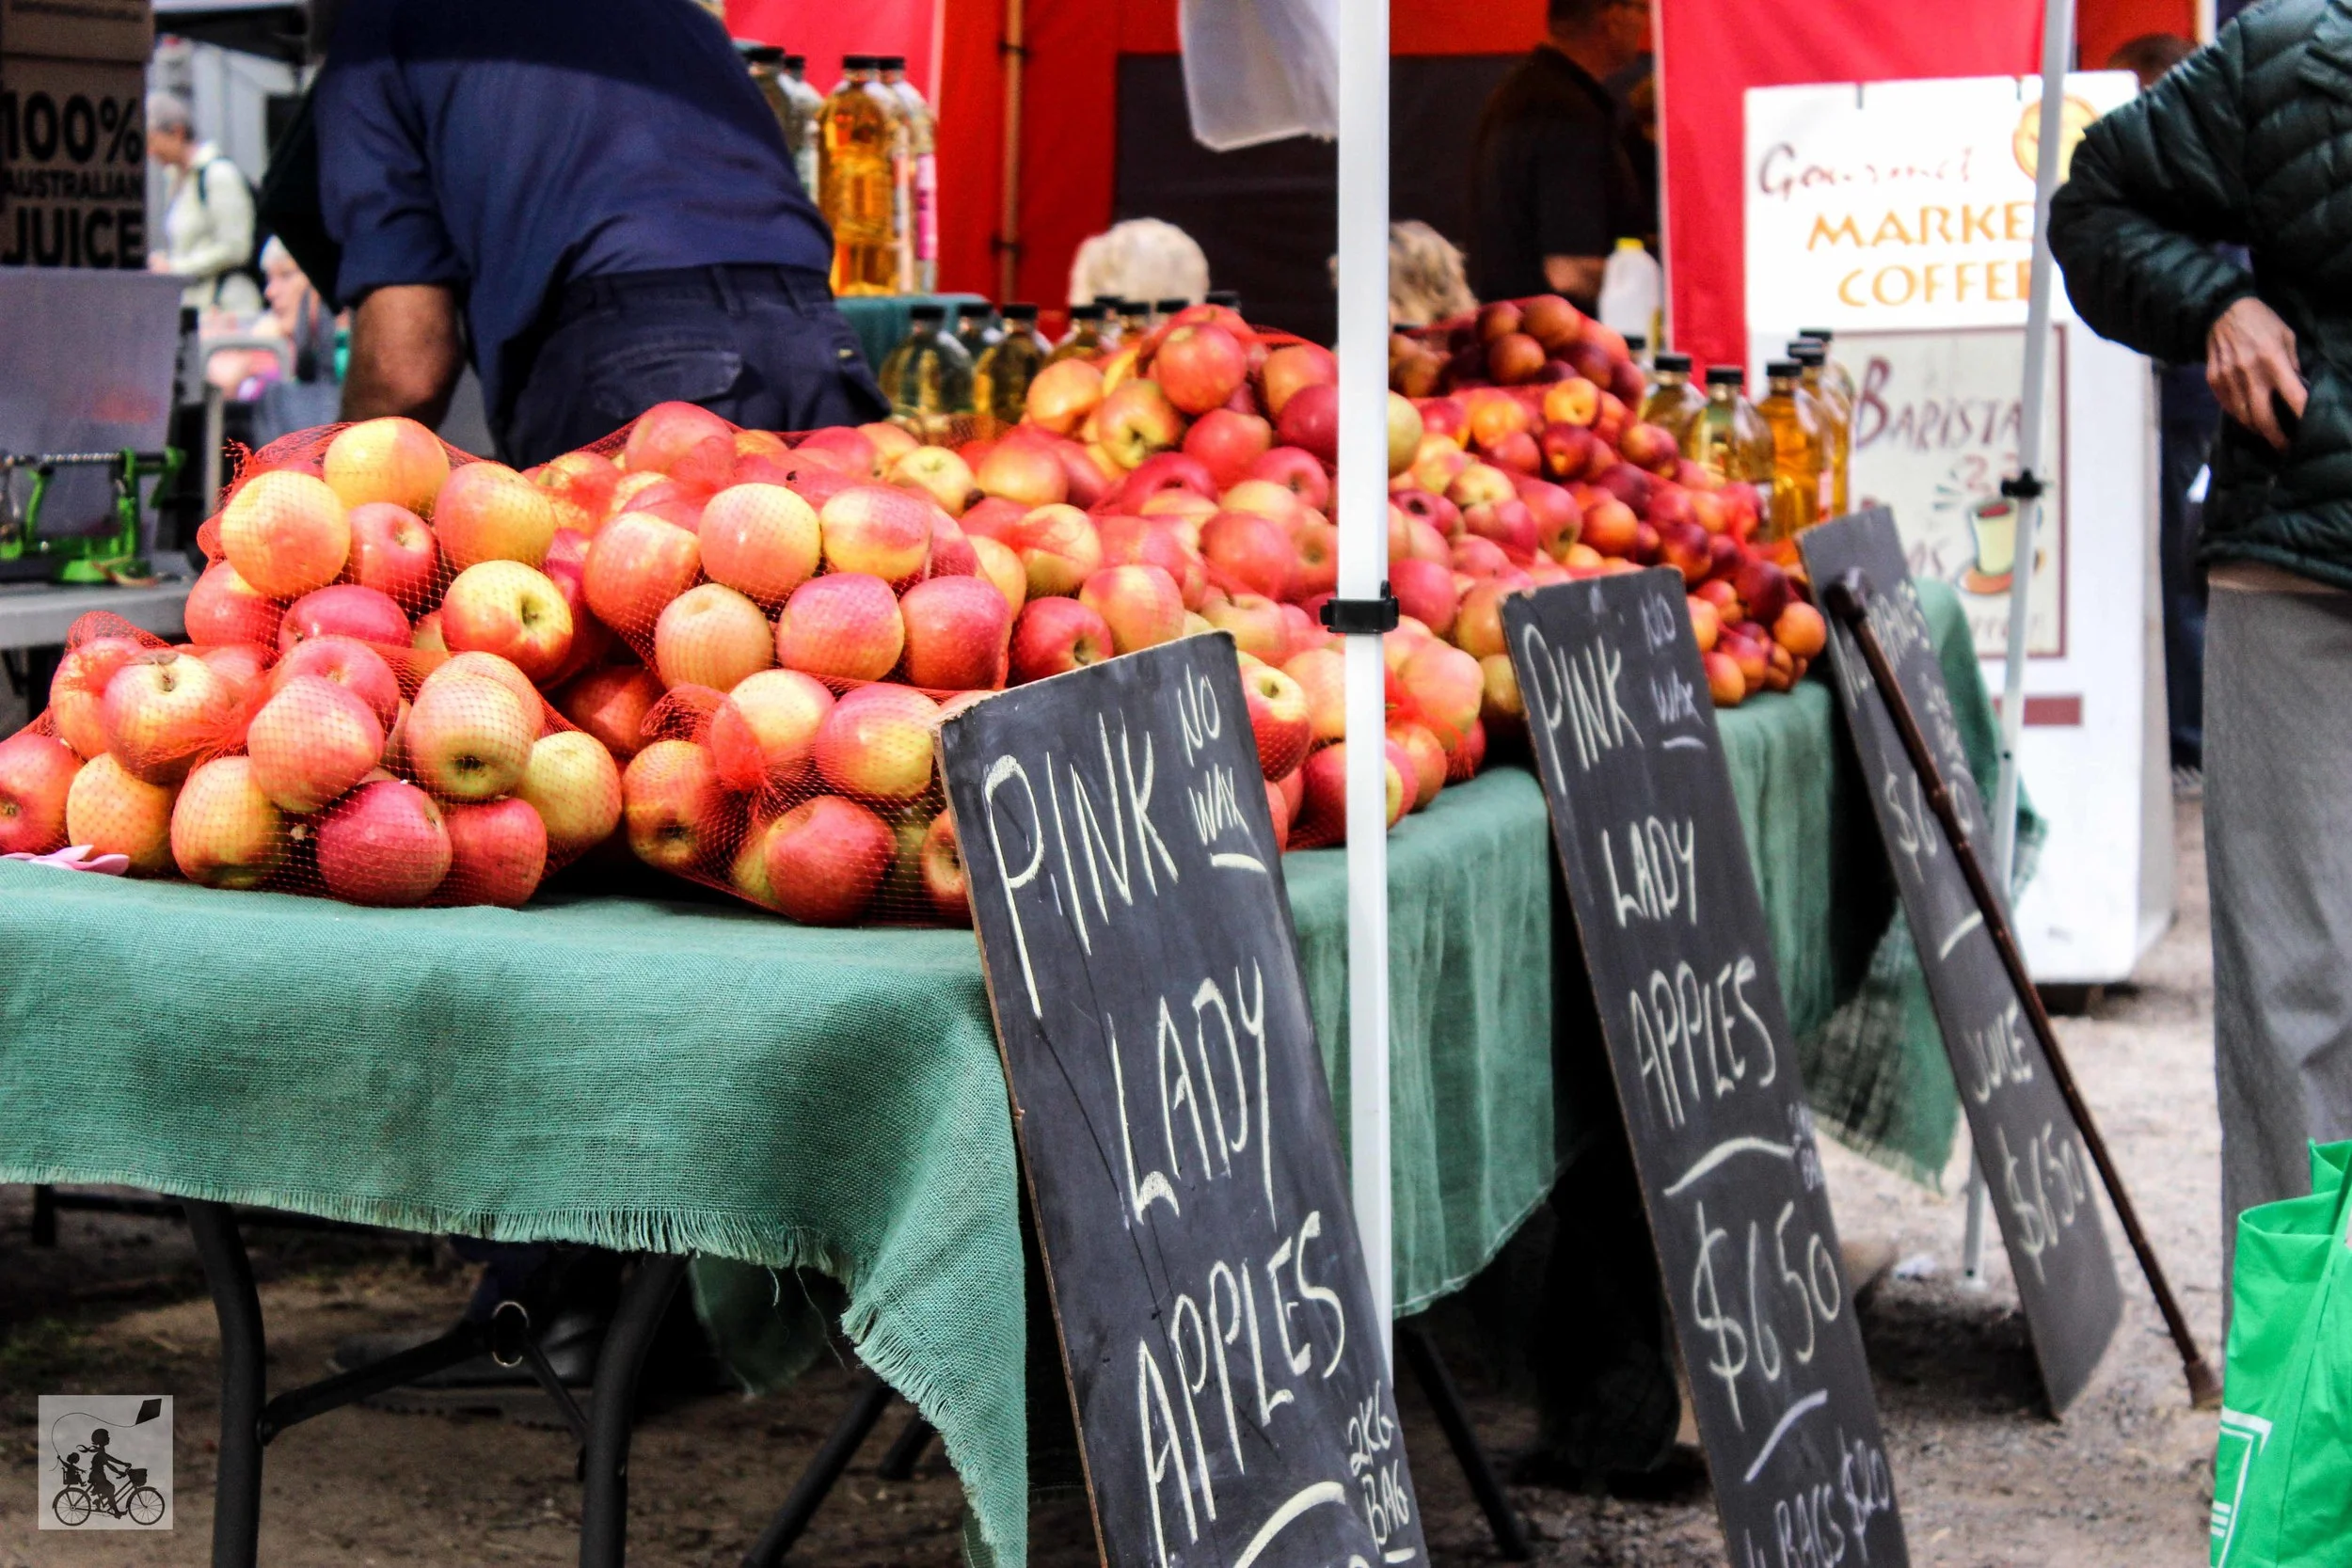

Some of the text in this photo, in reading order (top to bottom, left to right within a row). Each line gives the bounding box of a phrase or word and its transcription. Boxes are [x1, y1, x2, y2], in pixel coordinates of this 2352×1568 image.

[1, 91, 142, 165] 100%
[1, 168, 144, 199] AUSTRALIAN
[1806, 200, 2034, 252] MARKE
[2, 205, 144, 269] JUICE
[1638, 589, 1677, 656] NO
[1178, 663, 1221, 768] NO
[1522, 622, 1645, 797] PINK
[983, 707, 1180, 1020] PINK
[1601, 815, 1698, 928] LADY
[1629, 954, 1777, 1131] APPLES
[1106, 956, 1278, 1232] LADY
[1136, 1210, 1346, 1568] APPLES
[1348, 1379, 1395, 1478] 2KG
[1360, 1458, 1410, 1555] BAG
